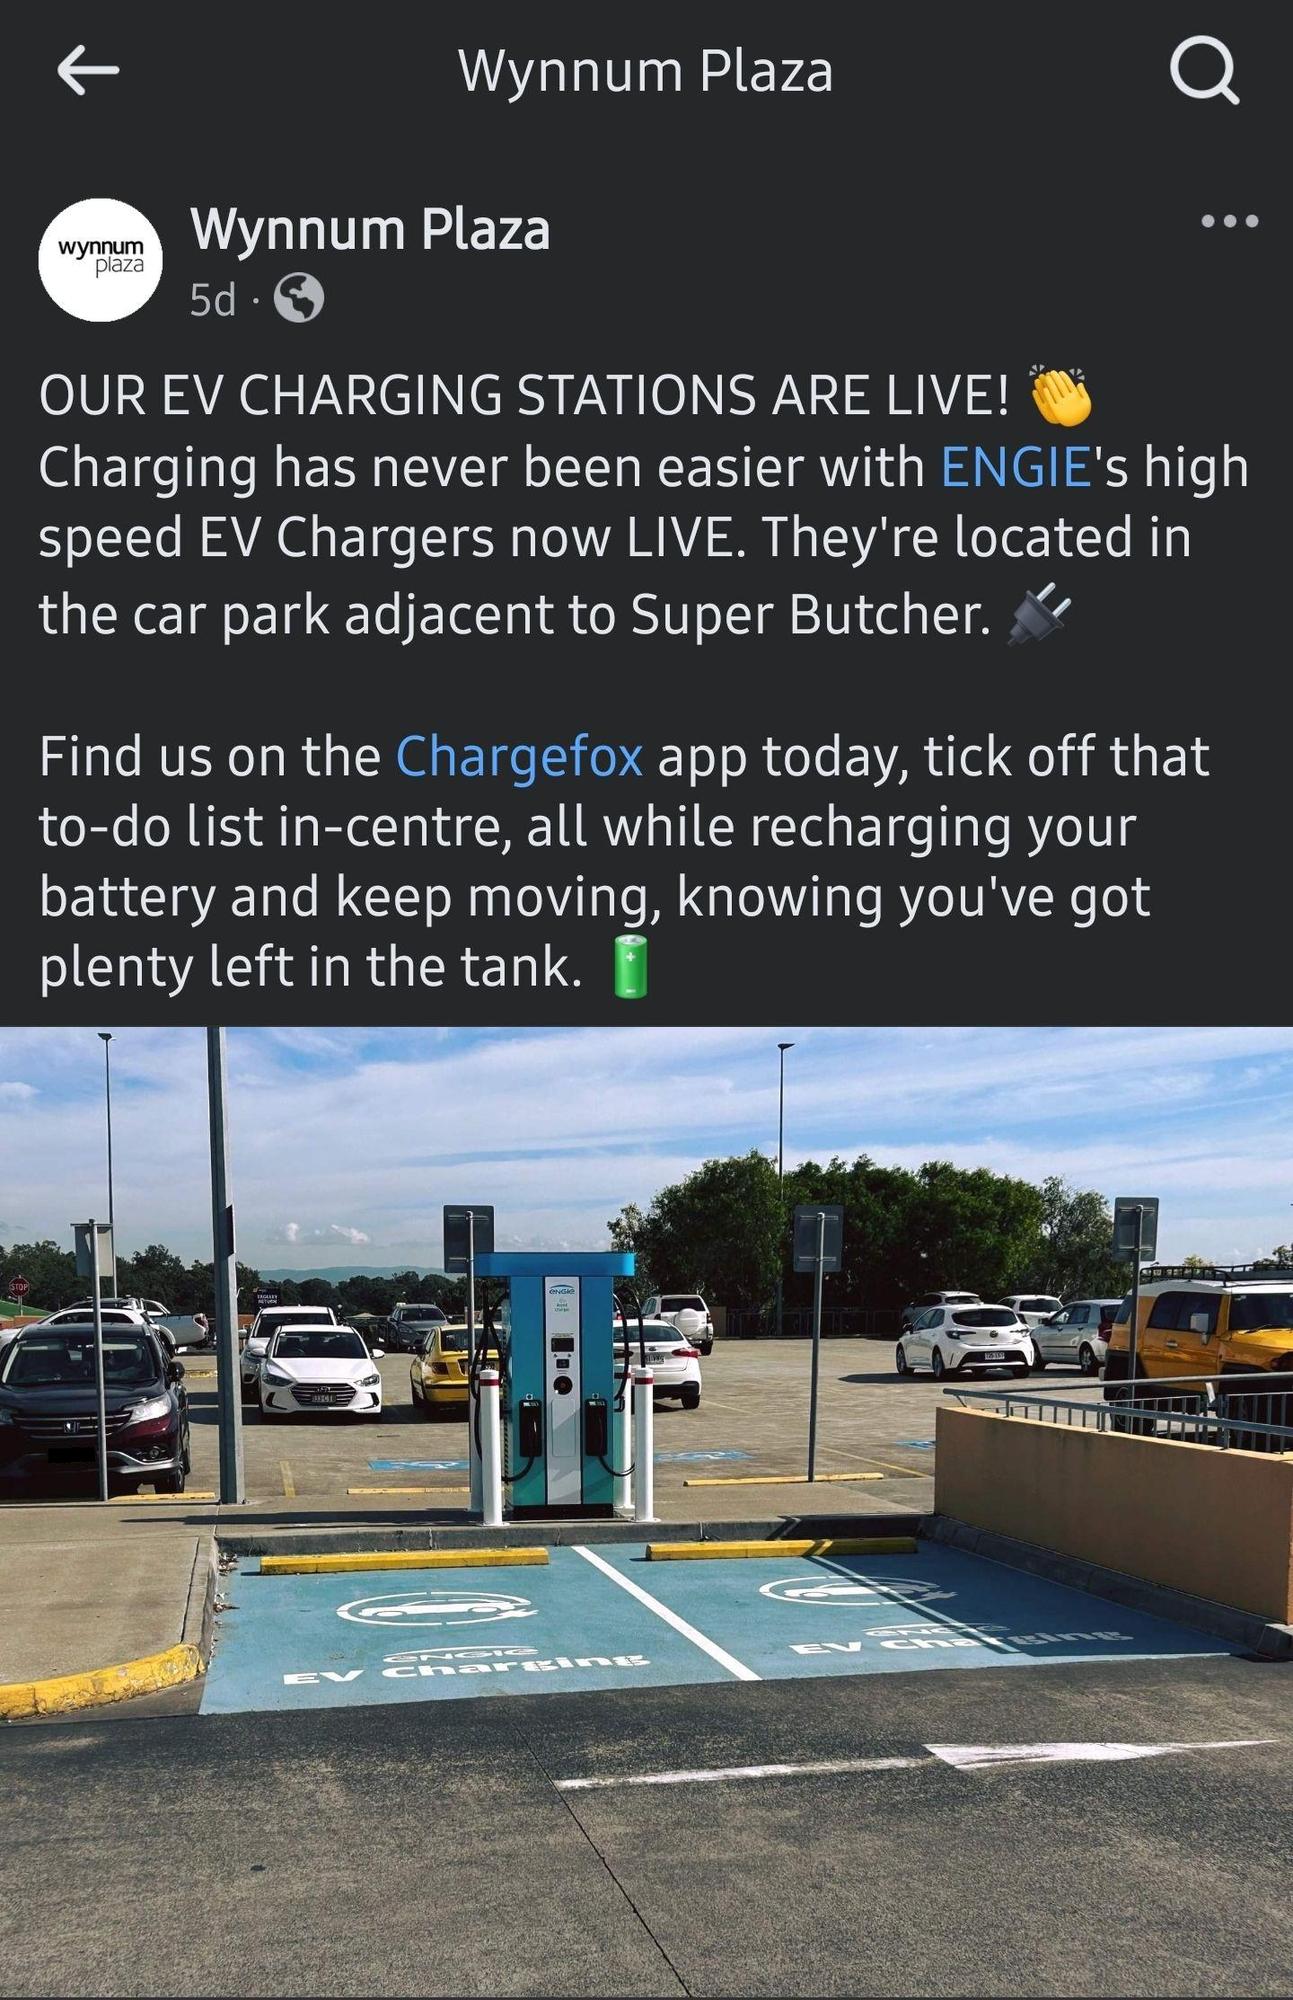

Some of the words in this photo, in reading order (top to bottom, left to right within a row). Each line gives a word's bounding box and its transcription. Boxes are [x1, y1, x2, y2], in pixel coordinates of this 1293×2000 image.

[10, 1283, 28, 1291] STOP
[789, 1641, 862, 1655] EV
[283, 1669, 365, 1686] EV
[381, 1654, 651, 1679] Charging
